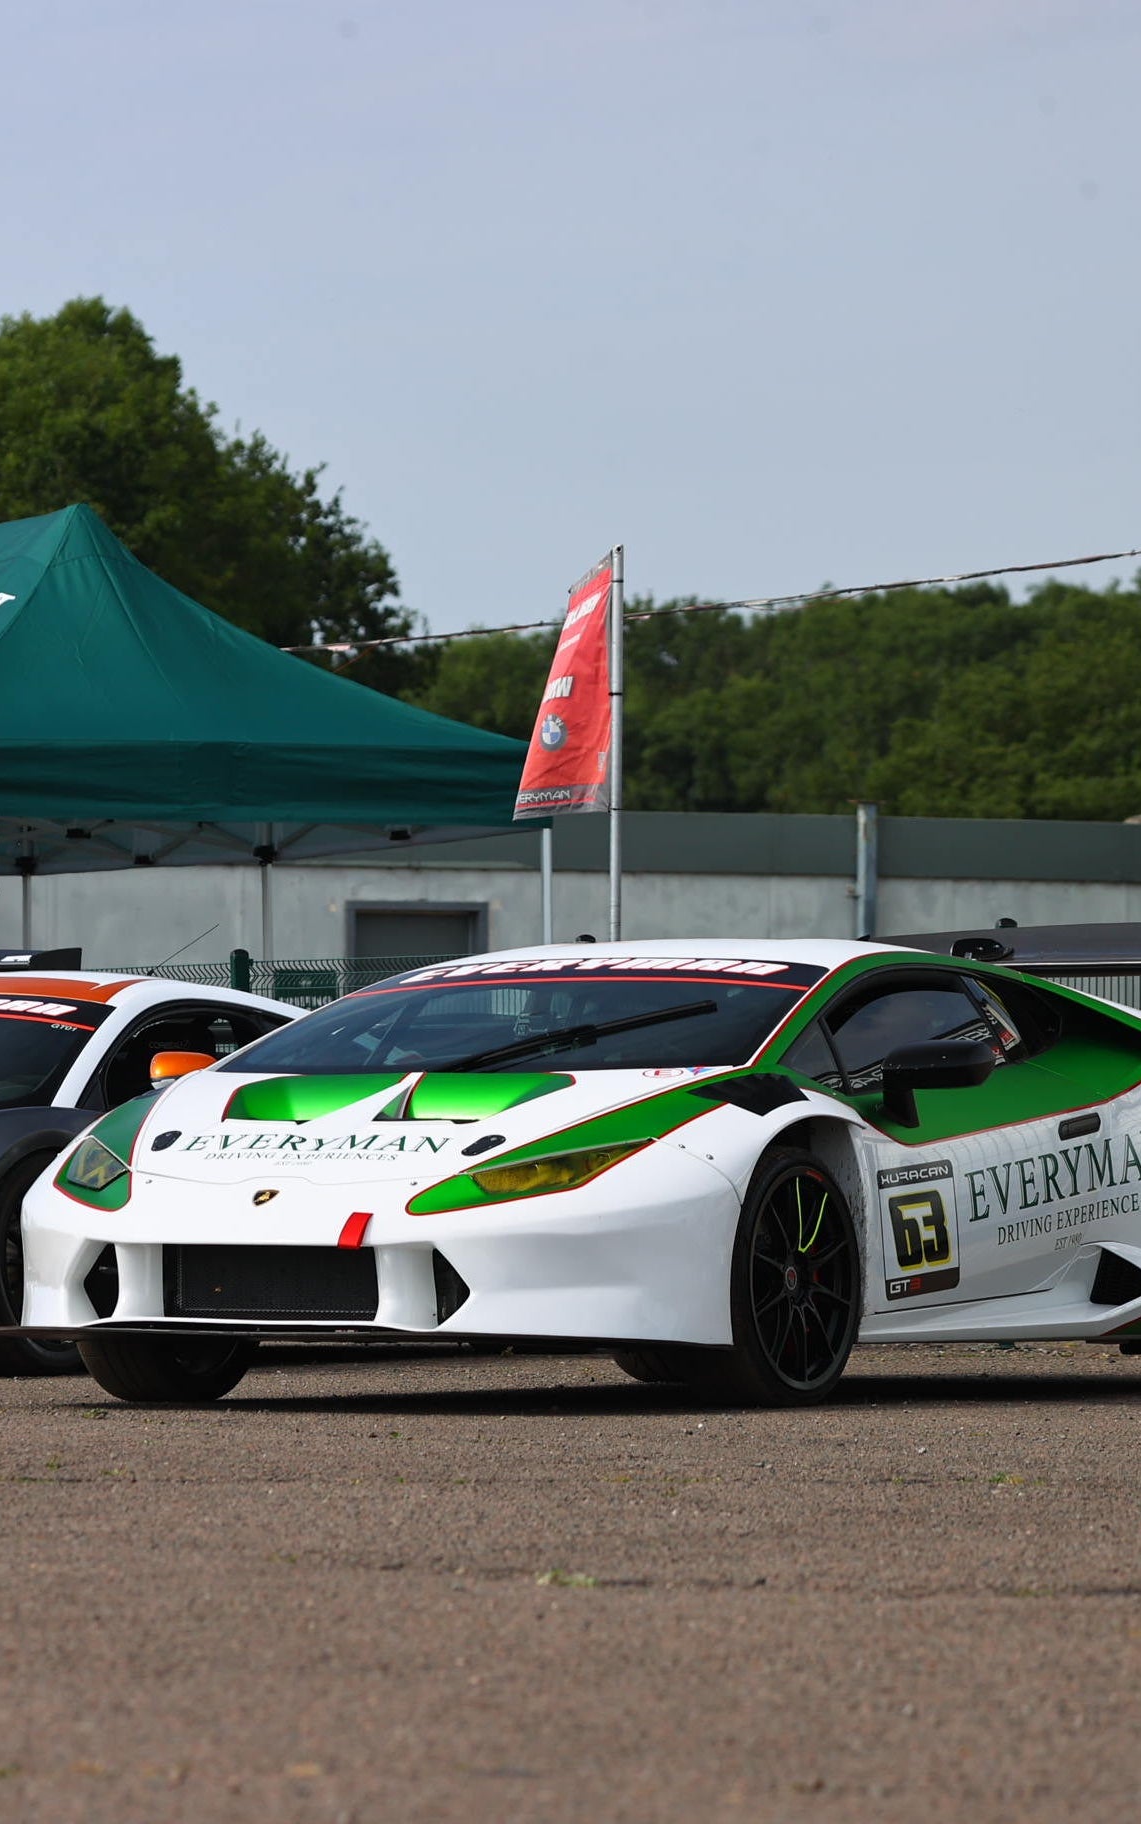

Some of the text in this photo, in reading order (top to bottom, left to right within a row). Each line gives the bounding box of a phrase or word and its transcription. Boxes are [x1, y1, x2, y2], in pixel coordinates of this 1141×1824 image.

[519, 789, 571, 804] ERYMAN
[398, 957, 790, 984] EVERYMAN
[179, 1133, 454, 1154] EVERYMAN
[204, 1151, 400, 1162] DRIVING EXPERIENCES
[880, 1164, 949, 1185] HURACAN
[964, 1131, 1141, 1223] EVERYMA
[997, 1192, 1141, 1246] DRIVING EXPERIENCE
[888, 1189, 952, 1271] 63
[889, 1277, 923, 1294] GT3
